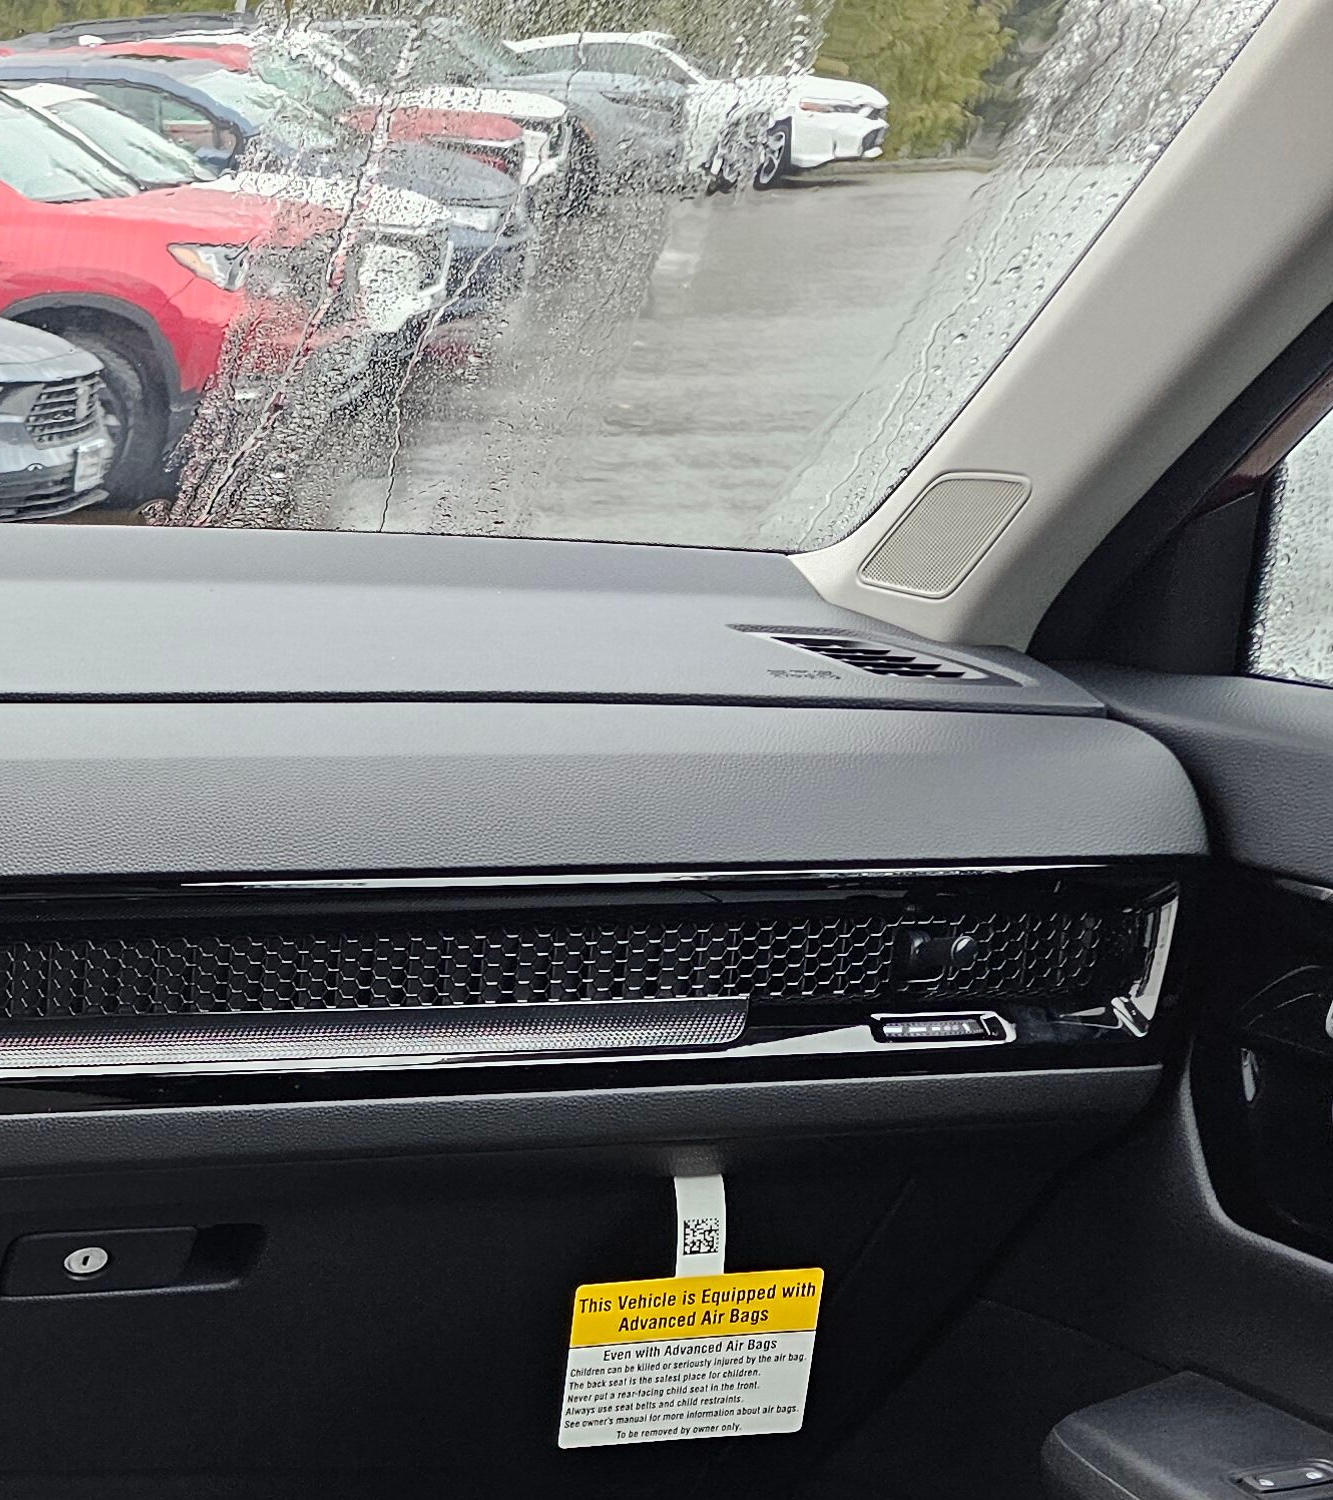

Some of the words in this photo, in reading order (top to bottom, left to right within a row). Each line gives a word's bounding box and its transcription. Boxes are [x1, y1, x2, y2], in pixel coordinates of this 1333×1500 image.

[579, 1297, 613, 1314] This
[617, 1292, 677, 1311] Vehicle
[682, 1290, 696, 1306] is
[701, 1283, 777, 1307] Equipped
[782, 1281, 816, 1299] with
[617, 1311, 697, 1333] Advanced
[700, 1309, 726, 1326] Air
[729, 1307, 770, 1326] Bags
[603, 1349, 632, 1362] Even
[635, 1346, 661, 1359] with
[663, 1341, 723, 1357] Advanced
[725, 1339, 745, 1353] Air
[747, 1338, 778, 1352] Bags
[570, 1367, 605, 1377] Children
[607, 1366, 622, 1374] can
[624, 1364, 634, 1373] be
[637, 1361, 660, 1371] killed
[662, 1362, 671, 1370] or
[673, 1358, 712, 1369] seriously
[713, 1355, 744, 1367] injured
[745, 1355, 756, 1365] by
[758, 1354, 771, 1363] the
[773, 1353, 786, 1362] air
[569, 1381, 584, 1390] The
[586, 1379, 606, 1388] back
[608, 1377, 627, 1387] seat
[629, 1376, 637, 1385] is
[638, 1376, 652, 1384] the
[654, 1373, 680, 1383] safest
[682, 1372, 706, 1383] place
[708, 1370, 721, 1379] for
[567, 1394, 592, 1403] Never
[593, 1392, 608, 1402] put
[666, 1385, 687, 1395] child
[689, 1384, 708, 1393] seat
[710, 1383, 718, 1391] in
[720, 1382, 734, 1391] the
[563, 1420, 580, 1428] See
[615, 1414, 647, 1424] manual
[649, 1413, 661, 1422] for
[662, 1412, 684, 1420] more
[686, 1408, 734, 1419] information
[736, 1406, 760, 1415] about
[761, 1405, 774, 1414] air
[564, 1407, 595, 1416] Always
[597, 1405, 612, 1413] use
[614, 1402, 633, 1412] seat
[635, 1401, 656, 1410] belts
[658, 1399, 674, 1408] and
[676, 1397, 698, 1407] child
[616, 1430, 626, 1439] To
[628, 1430, 638, 1438] be
[641, 1426, 678, 1437] removed
[680, 1426, 691, 1435] by
[692, 1425, 719, 1433] owner
